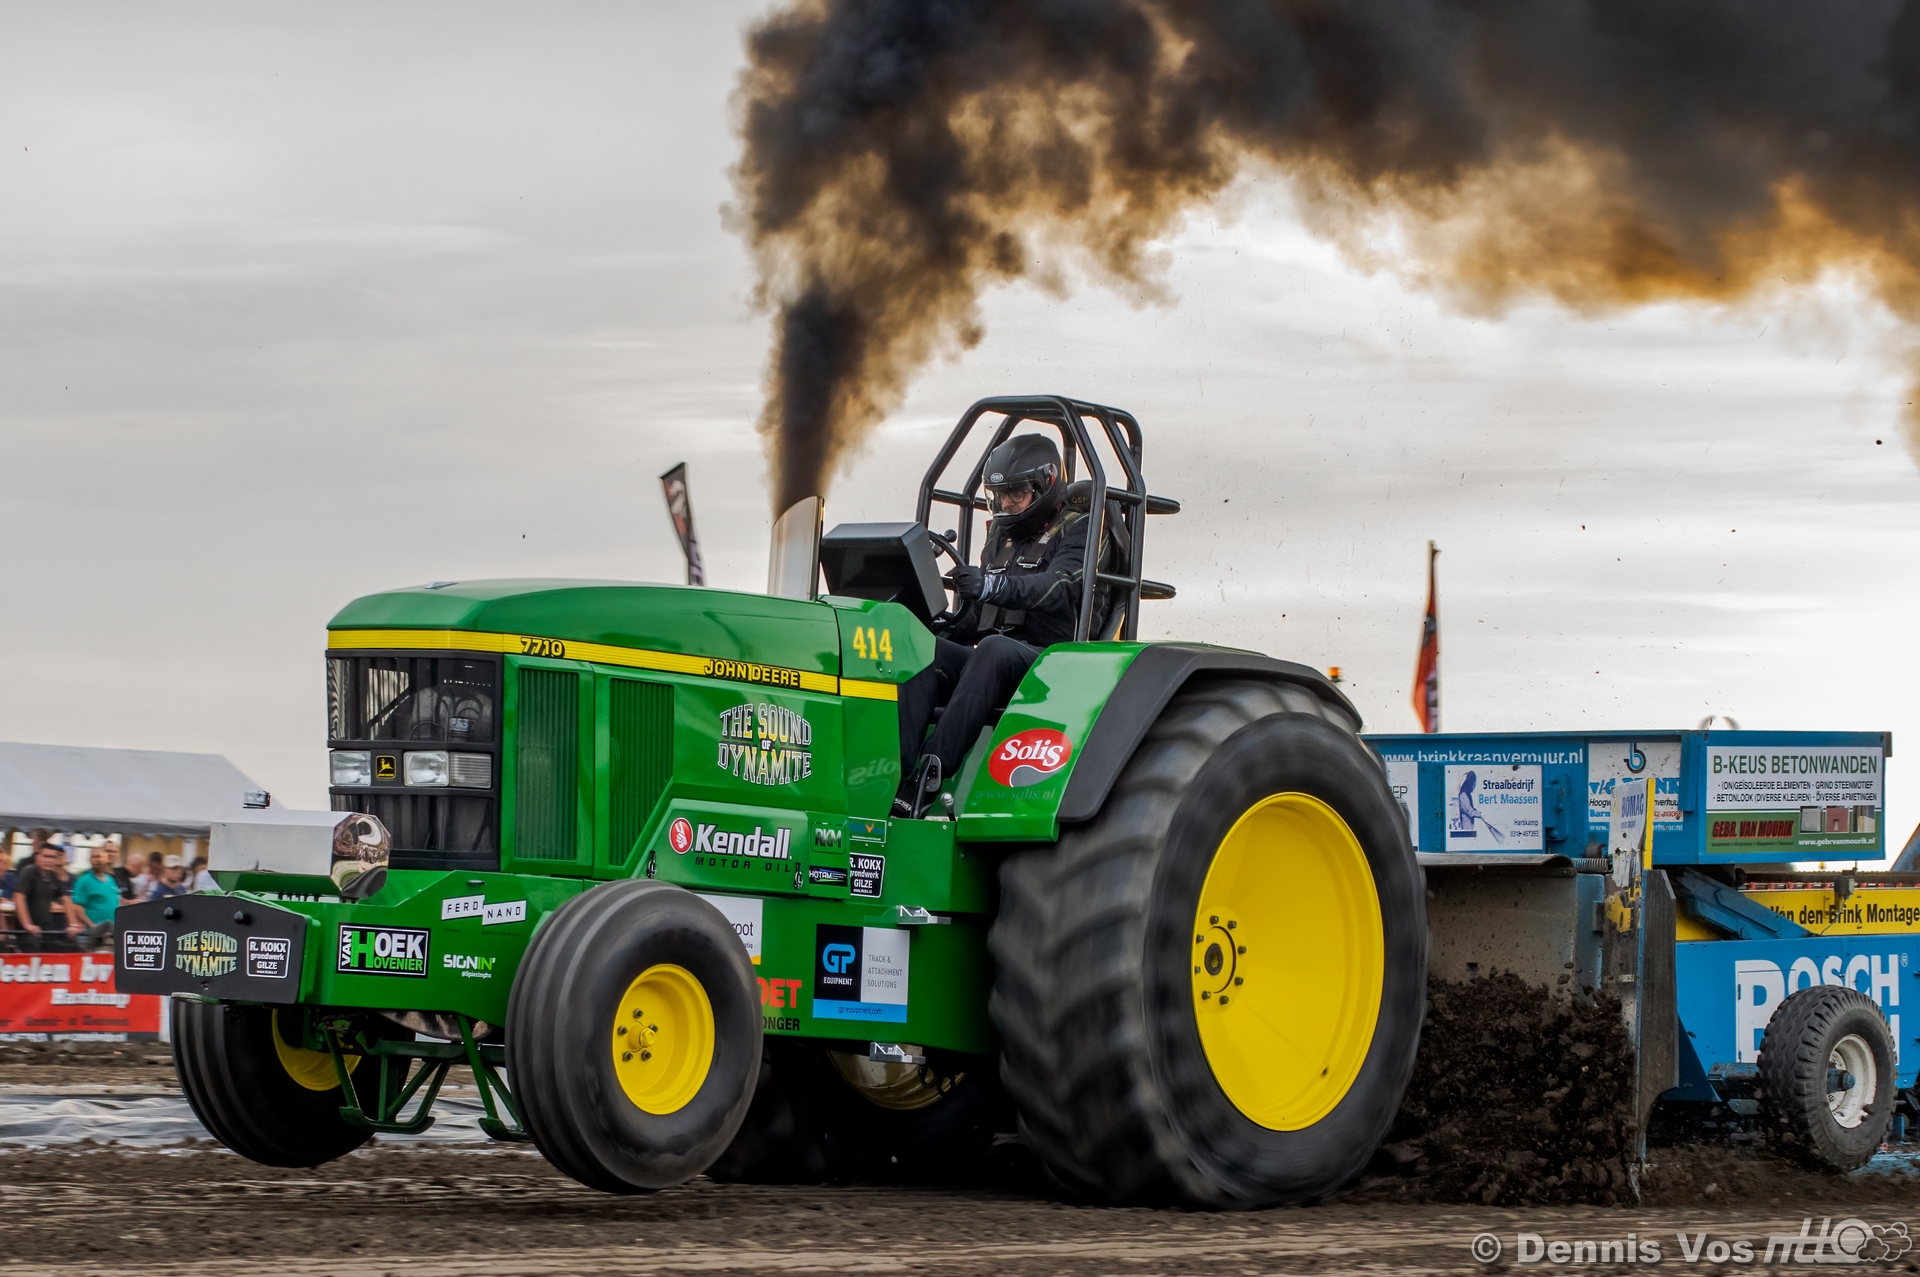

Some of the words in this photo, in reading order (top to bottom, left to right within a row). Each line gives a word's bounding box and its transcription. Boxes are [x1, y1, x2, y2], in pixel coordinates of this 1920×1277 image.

[521, 637, 564, 658] 7710
[853, 626, 893, 662] 414
[704, 659, 748, 681] JOHN
[750, 665, 800, 687] DEERE
[720, 703, 754, 739] THE
[758, 702, 812, 746] SOUND
[761, 740, 772, 750] OF
[1000, 739, 1064, 767] Solis
[718, 742, 812, 786] DYNAMITE
[1713, 755, 1767, 774] B-KEUS
[1771, 755, 1877, 774] BETONWANDEN
[1483, 779, 1534, 792] Straalbedrijf
[1776, 781, 1811, 790] ELEMENTEN
[1834, 780, 1874, 789] STEENMOTIEF
[1478, 794, 1498, 805] Bert
[1501, 794, 1538, 805] Maassen
[1716, 793, 1753, 803] BETONLOOK
[1842, 792, 1877, 801] AFMETINGEN
[1621, 793, 1645, 819] BOMAG
[1712, 820, 1737, 839] GEBR.
[1739, 820, 1757, 839] VAN
[1757, 820, 1795, 839] MOURIK
[693, 823, 791, 859] Kendall
[815, 828, 842, 849] RKM
[1798, 838, 1876, 847] www.gebrvanmourik.nl
[695, 857, 751, 869] MOTOR
[765, 862, 790, 873] OIL
[858, 858, 882, 871] KOKX
[854, 879, 873, 888] GILZE
[1799, 905, 1823, 925] den
[1828, 904, 1862, 924] Brink
[1867, 904, 1920, 926] Montage
[126, 935, 136, 945] R.
[138, 935, 163, 946] KOKX
[176, 931, 199, 951] THE
[201, 930, 238, 954] SOUND
[250, 941, 259, 951] R.
[261, 942, 287, 953] KOKX
[127, 946, 161, 954] grondwerk
[341, 930, 352, 966] VAN
[134, 954, 155, 963] GILZE
[250, 953, 285, 961] grondwerk
[823, 943, 856, 974] GP
[868, 954, 886, 963] TRACK
[887, 956, 892, 964] &
[175, 954, 238, 977] DYNAMITE
[257, 961, 278, 970] GILZE
[868, 967, 903, 977] ATTACHMENT
[823, 976, 853, 986] EQUIPMENT
[867, 979, 898, 989] SOLUTIONS
[838, 1006, 883, 1015] gp-equipment.com
